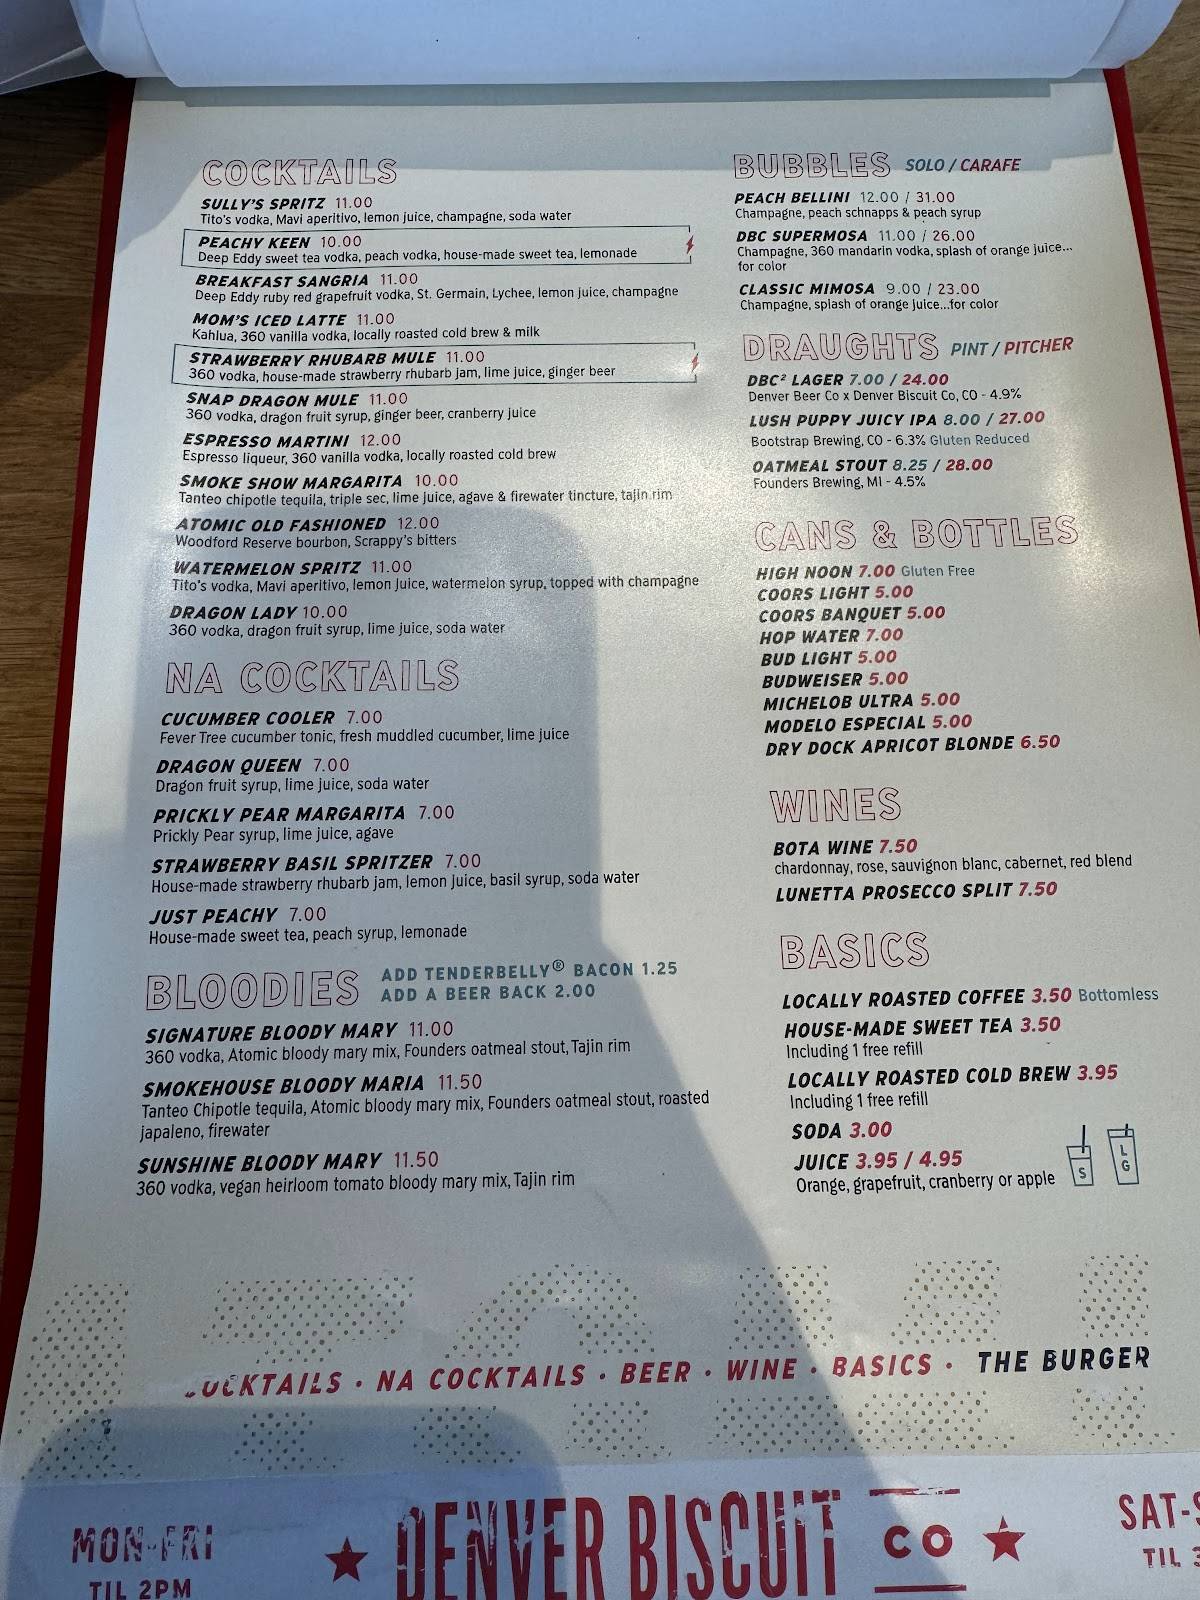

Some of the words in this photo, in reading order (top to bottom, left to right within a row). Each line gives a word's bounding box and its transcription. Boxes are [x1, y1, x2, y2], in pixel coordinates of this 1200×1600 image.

[202, 158, 397, 186] COCKTAILS
[734, 152, 891, 178] BUBBLES
[905, 159, 944, 172] SOLO
[948, 158, 957, 172] /
[961, 158, 1021, 171] CARAFE
[201, 198, 264, 210] SULLY'S
[269, 198, 326, 210] SPRITZ
[336, 197, 372, 208] 11.00
[734, 192, 786, 204] PEACH
[791, 192, 850, 203] BELLINI
[861, 192, 898, 202] 12.00
[906, 192, 910, 204] /
[917, 192, 954, 202] 31.00
[200, 214, 231, 224] Tito's
[235, 214, 272, 226] vodka,
[276, 214, 302, 224] Mavi
[307, 212, 360, 226] aperitivo,
[364, 212, 399, 222] lemon
[403, 212, 433, 224] juice,
[437, 211, 505, 224] champagne,
[509, 211, 536, 221] soda
[540, 211, 572, 220] water
[736, 208, 805, 220] Champagne,
[808, 207, 842, 220] peach
[846, 207, 898, 219] schnapps
[902, 208, 910, 217] &
[914, 207, 946, 220] peach
[951, 210, 981, 220] syrup
[743, 332, 938, 361] DRAUGHTS
[951, 342, 989, 356] PINT
[992, 342, 1000, 356] /
[1004, 337, 1074, 355] PITCHER
[792, 374, 844, 386] LAGER
[850, 374, 884, 385] 7.00
[890, 374, 898, 386] /
[902, 374, 948, 385] 24.00
[752, 436, 809, 448] Bootstrap
[814, 434, 864, 448] Brewing,
[867, 435, 882, 446] CO
[896, 435, 926, 446] 6.3%
[930, 435, 970, 446] Gluten
[976, 433, 1029, 445] Reduced
[183, 450, 238, 464] Espresso
[243, 452, 288, 466] liqueur,
[292, 452, 316, 464] 360
[321, 452, 359, 463] vanilla
[364, 450, 403, 462] vodka,
[407, 450, 445, 463] locally
[450, 449, 493, 460] roasted
[498, 448, 523, 460] cold
[528, 448, 556, 459] brew
[175, 518, 246, 532] ATOMIC
[252, 520, 284, 532] OLD
[289, 518, 386, 532] FASHIONED
[398, 516, 439, 529] 12.00
[755, 520, 856, 551] CANS
[873, 520, 897, 548] &
[912, 515, 1079, 548] BOTTLES
[176, 534, 238, 548] Woodford
[243, 537, 291, 548] Reserve
[296, 536, 350, 548] bourbon,
[355, 534, 412, 548] Scrappy's
[417, 534, 456, 546] bitters
[756, 566, 799, 580] HIGH
[804, 565, 852, 579] NOON
[859, 564, 895, 578] 7.00
[902, 566, 943, 576] Gluten
[948, 566, 974, 576] Free
[758, 587, 814, 601] COORS
[820, 586, 870, 600] LIGHT
[875, 585, 913, 598] 5.00
[169, 605, 246, 620] DRAGON
[250, 606, 298, 620] LADY
[304, 605, 347, 618] 10.00
[166, 661, 223, 694] NA
[240, 659, 460, 693] COCKTAILS
[162, 712, 260, 726] CUCUMBER
[266, 711, 335, 725] COOLER
[348, 710, 382, 724] 7.00
[766, 742, 802, 756] DRY
[808, 740, 856, 755] DOCK
[860, 738, 939, 753] APRICOT
[945, 736, 1014, 751] BLONDE
[1021, 735, 1060, 749] 6.50
[153, 807, 236, 823] PRICKLY
[240, 808, 289, 822] PEAR
[296, 806, 404, 821] MARGARITA
[419, 805, 454, 819] 7.00
[770, 787, 902, 823] WINES
[773, 841, 819, 856] BOTA
[828, 840, 873, 855] WINE
[880, 839, 917, 853] 7.50
[775, 861, 853, 876] chardonnay,
[857, 862, 888, 874] rose,
[892, 858, 957, 874] sauvignon
[962, 857, 1001, 871] blanc,
[1005, 856, 1066, 869] cabernet,
[1070, 854, 1090, 868] red
[1096, 854, 1132, 867] blend
[780, 931, 929, 969] BASICS
[382, 968, 417, 982] ADD
[574, 963, 633, 976] BACON
[642, 962, 677, 975] 1.25
[146, 969, 359, 1010] BLOODIES
[784, 1020, 906, 1038] HOUSE-MADE
[913, 1019, 973, 1035] SWEET
[980, 1018, 1012, 1033] TEA
[1020, 1016, 1060, 1032] 3.50
[787, 1044, 849, 1060] Including
[853, 1043, 858, 1057] 1
[862, 1043, 888, 1056] free
[894, 1041, 922, 1056] refill
[142, 1079, 276, 1098] SMOKEHOUSE
[280, 1077, 357, 1094] BLOODY
[360, 1075, 423, 1092] MARIA
[439, 1074, 482, 1090] 11.50
[140, 1124, 204, 1143] japaleno,
[208, 1123, 270, 1138] firewater
[794, 1154, 849, 1171] JUICE
[856, 1152, 897, 1169] 3.95
[904, 1151, 913, 1170] /
[919, 1150, 962, 1167] 4.95
[797, 1178, 850, 1195] Orange,
[854, 1174, 925, 1195] grapefruit,
[929, 1173, 993, 1191] cranberry
[999, 1175, 1012, 1186] or
[1018, 1170, 1055, 1189] apple
[184, 1371, 343, 1398] OCKTAILS
[377, 1370, 413, 1391] NA
[429, 1364, 586, 1390] COCKTAILS
[620, 1361, 690, 1384] BEER
[727, 1358, 798, 1380] WINE
[832, 1353, 932, 1377] BASICS
[978, 1350, 1028, 1373] THE
[1043, 1345, 1150, 1371] BURGER
[397, 1497, 605, 1600] DENVER
[629, 1490, 841, 1600] BISCUIT
[884, 1524, 953, 1559] CO
[1143, 1547, 1181, 1568] TIL
[89, 1580, 127, 1600] TIL
[139, 1578, 191, 1599] 2PM
